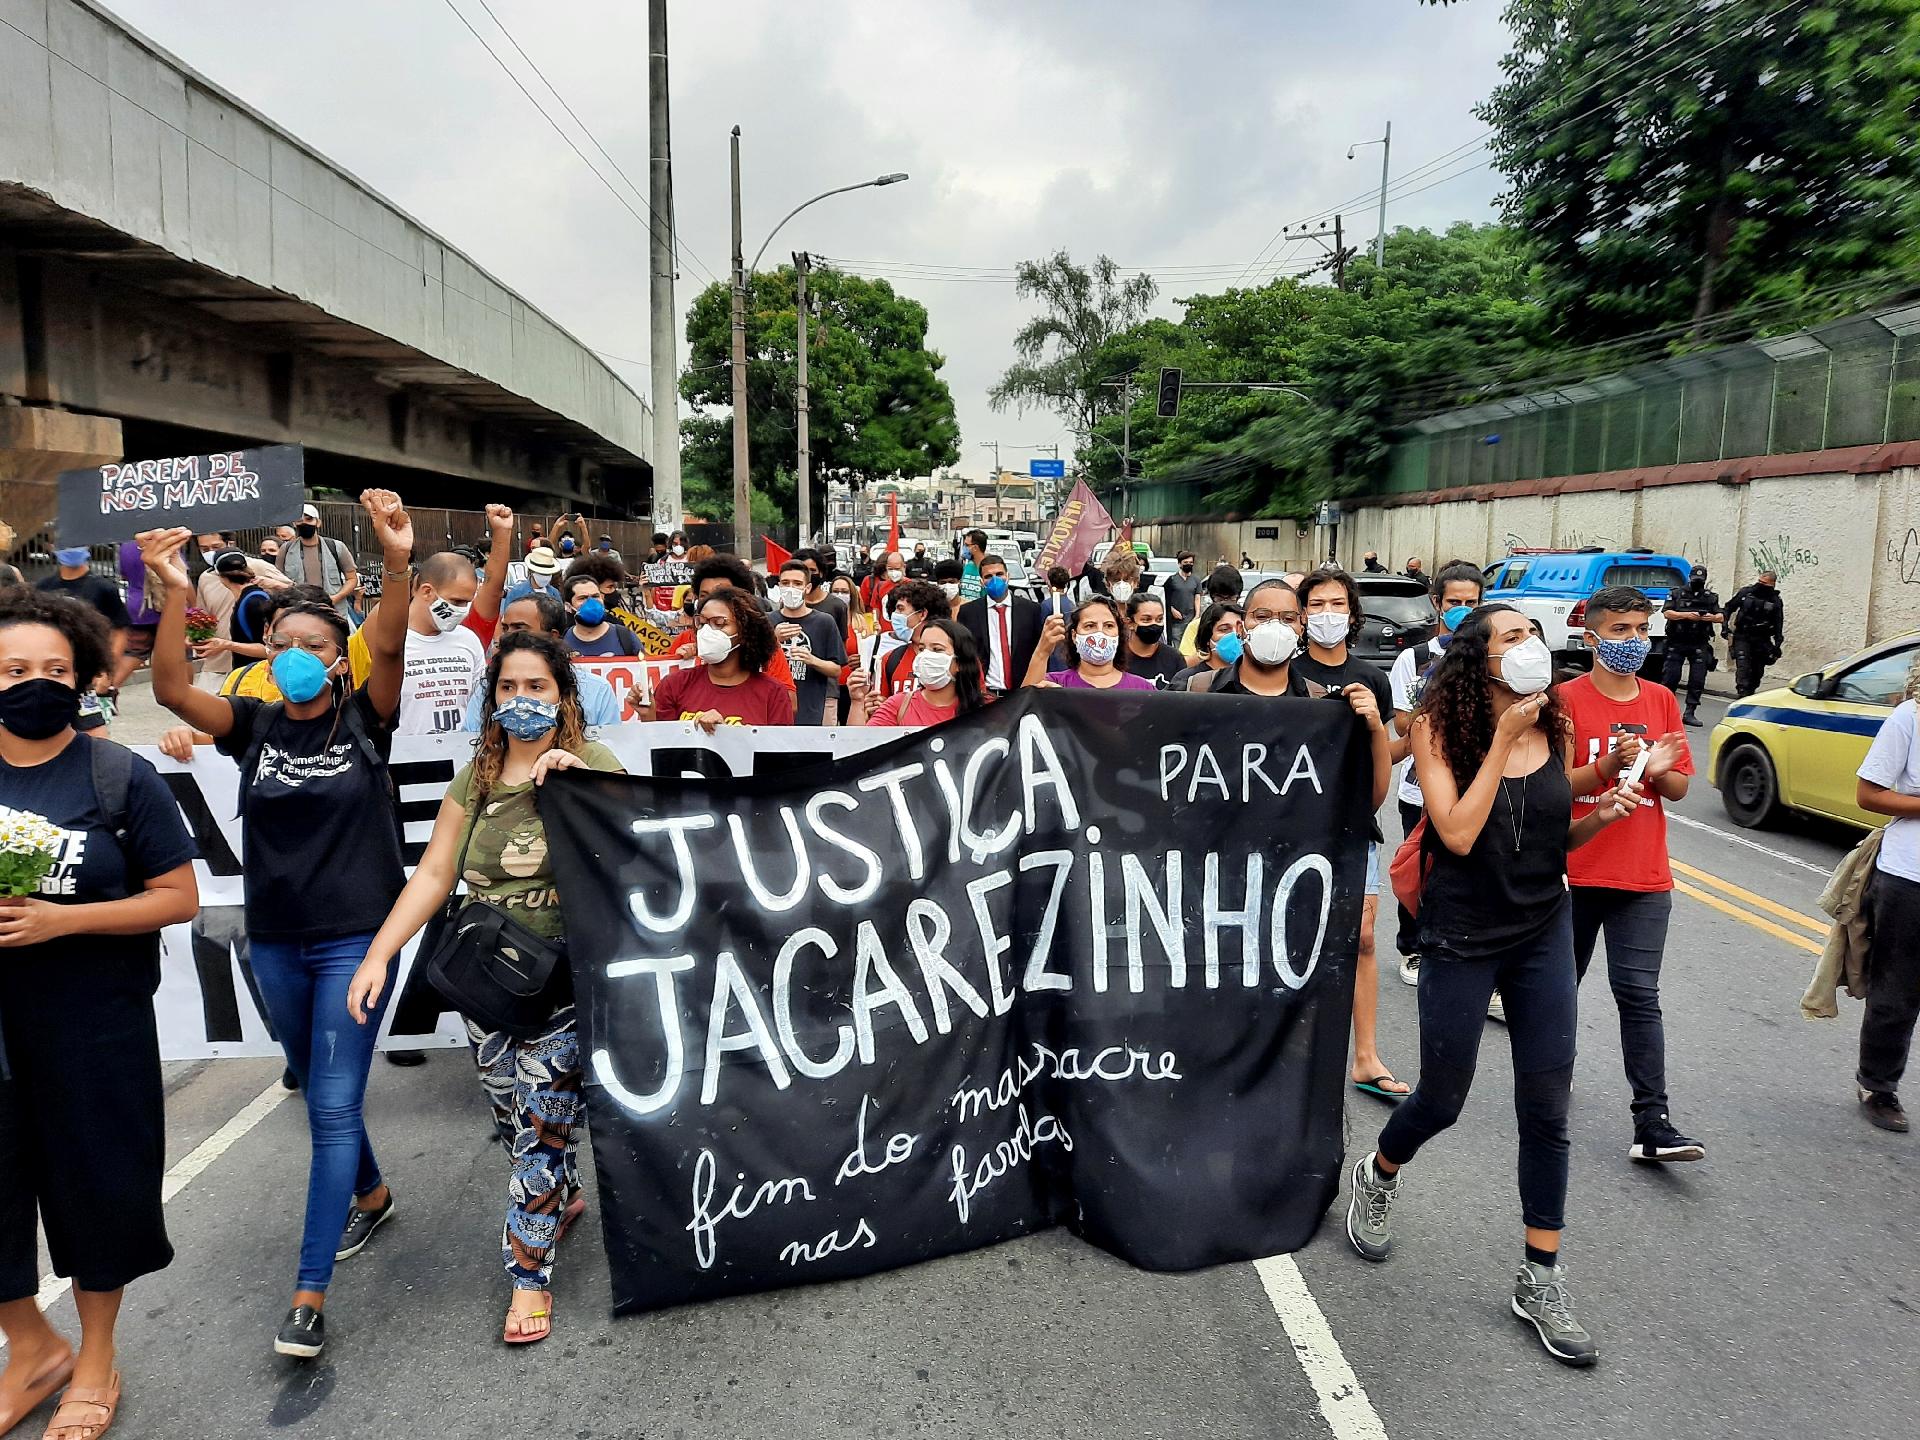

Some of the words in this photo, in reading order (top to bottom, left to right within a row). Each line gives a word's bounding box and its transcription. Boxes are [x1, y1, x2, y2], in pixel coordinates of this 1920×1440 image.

[100, 455, 199, 490] PAREM
[209, 451, 246, 478] DE
[101, 485, 158, 514] NOS
[163, 472, 260, 510] MATAR
[405, 669, 424, 678] NÃO
[418, 680, 436, 688] NÃO
[433, 708, 461, 732] UP
[280, 749, 326, 765] Moviment
[629, 714, 1081, 934] JUSTIÇA
[1158, 742, 1325, 803] PARA
[590, 826, 1335, 1116] JACAREZINHO
[686, 1150, 817, 1269] fim
[834, 1093, 923, 1187] do
[951, 1042, 1183, 1124] massacre
[779, 1217, 876, 1266] nas
